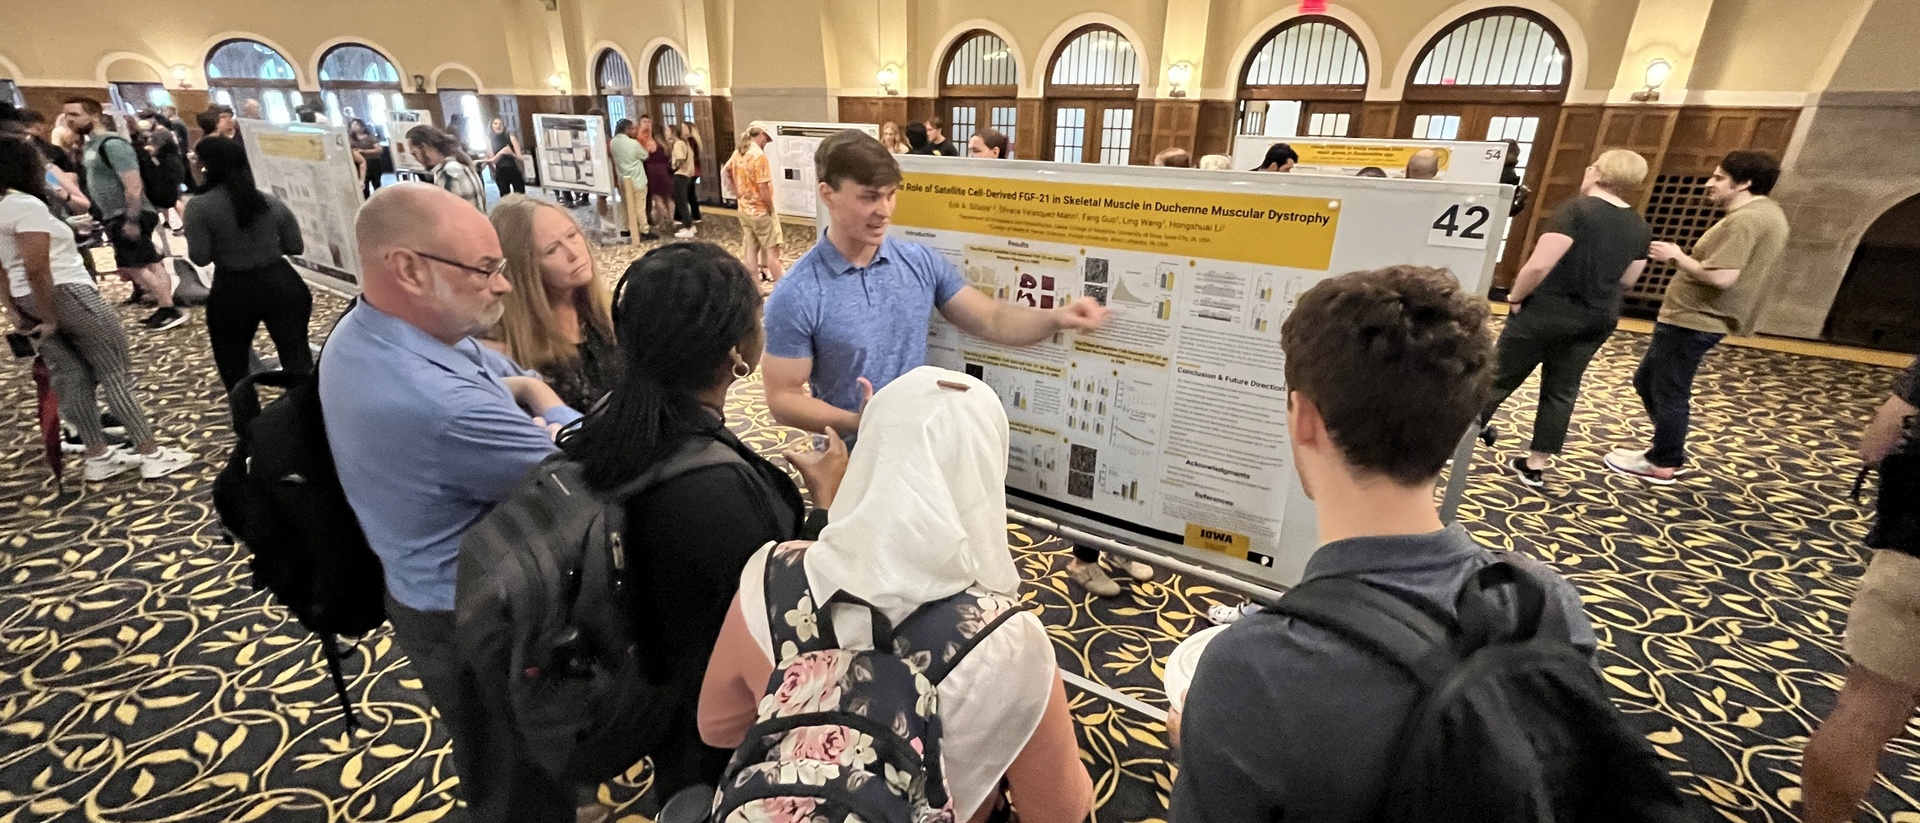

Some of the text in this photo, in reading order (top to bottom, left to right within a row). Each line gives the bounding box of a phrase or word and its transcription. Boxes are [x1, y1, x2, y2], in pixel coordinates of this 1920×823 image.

[1484, 149, 1501, 160] 54
[906, 182, 923, 192] Role
[925, 184, 933, 193] of
[934, 185, 966, 196] Satellite
[967, 187, 1017, 200] Cell-Derived
[1019, 191, 1050, 204] FGF-21
[1052, 194, 1061, 204] in
[1063, 195, 1102, 207] Skeletal
[1103, 198, 1140, 210] Muscle
[1142, 200, 1152, 211] in
[1154, 201, 1209, 216] Duchenne
[1211, 205, 1265, 220] Muscular
[1268, 209, 1331, 227] Dystrophy
[1432, 204, 1490, 239] 42
[1177, 366, 1217, 380] Conclusion
[1225, 375, 1249, 386] Future
[1194, 491, 1234, 506] References
[1200, 529, 1233, 543] IOWA
